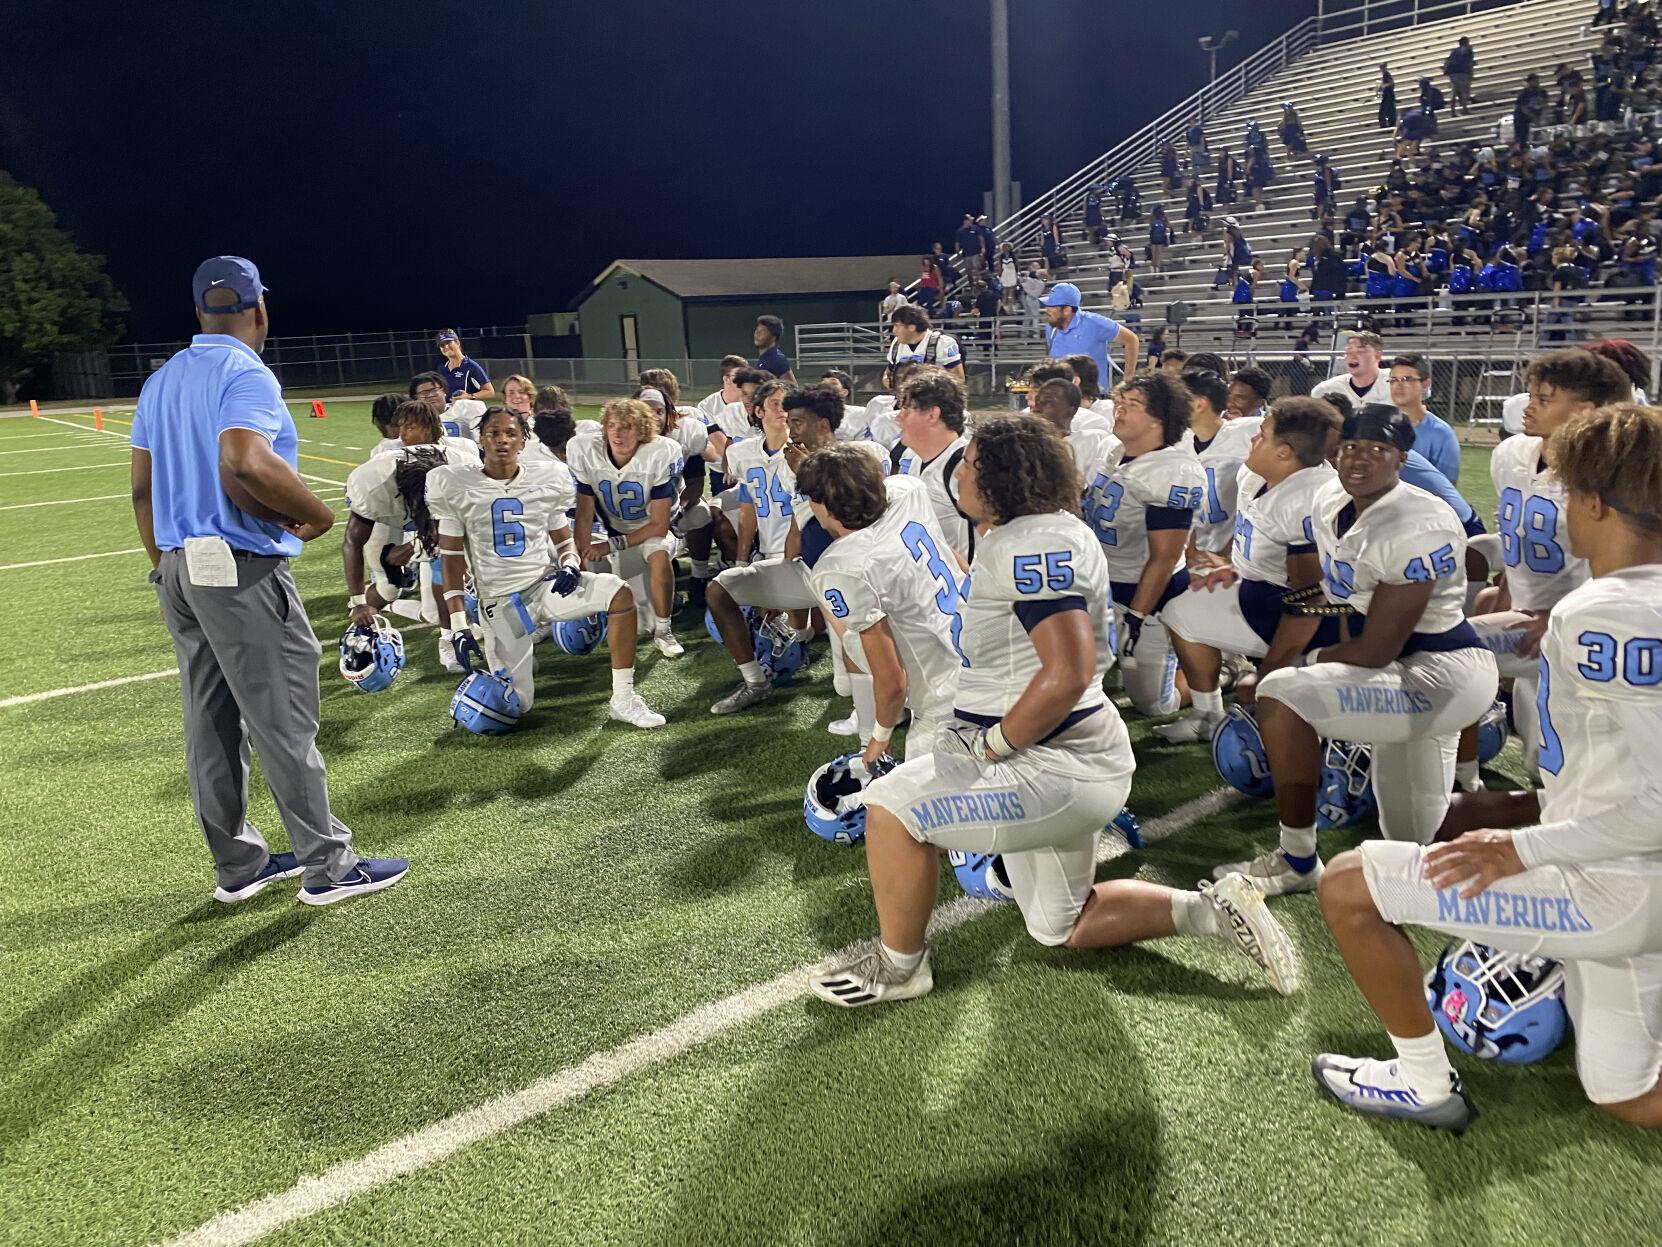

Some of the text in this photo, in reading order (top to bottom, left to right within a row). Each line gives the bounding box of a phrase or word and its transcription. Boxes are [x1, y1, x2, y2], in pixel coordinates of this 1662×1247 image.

[598, 479, 648, 520] 12
[491, 497, 526, 557] 6
[1500, 487, 1565, 574] 88
[1014, 550, 1075, 594] 55
[1404, 543, 1457, 582] 45
[825, 588, 850, 618] 3
[1577, 630, 1662, 686] 30
[1336, 686, 1433, 715] MAVERICKS
[911, 791, 1026, 832] MAVERICKS
